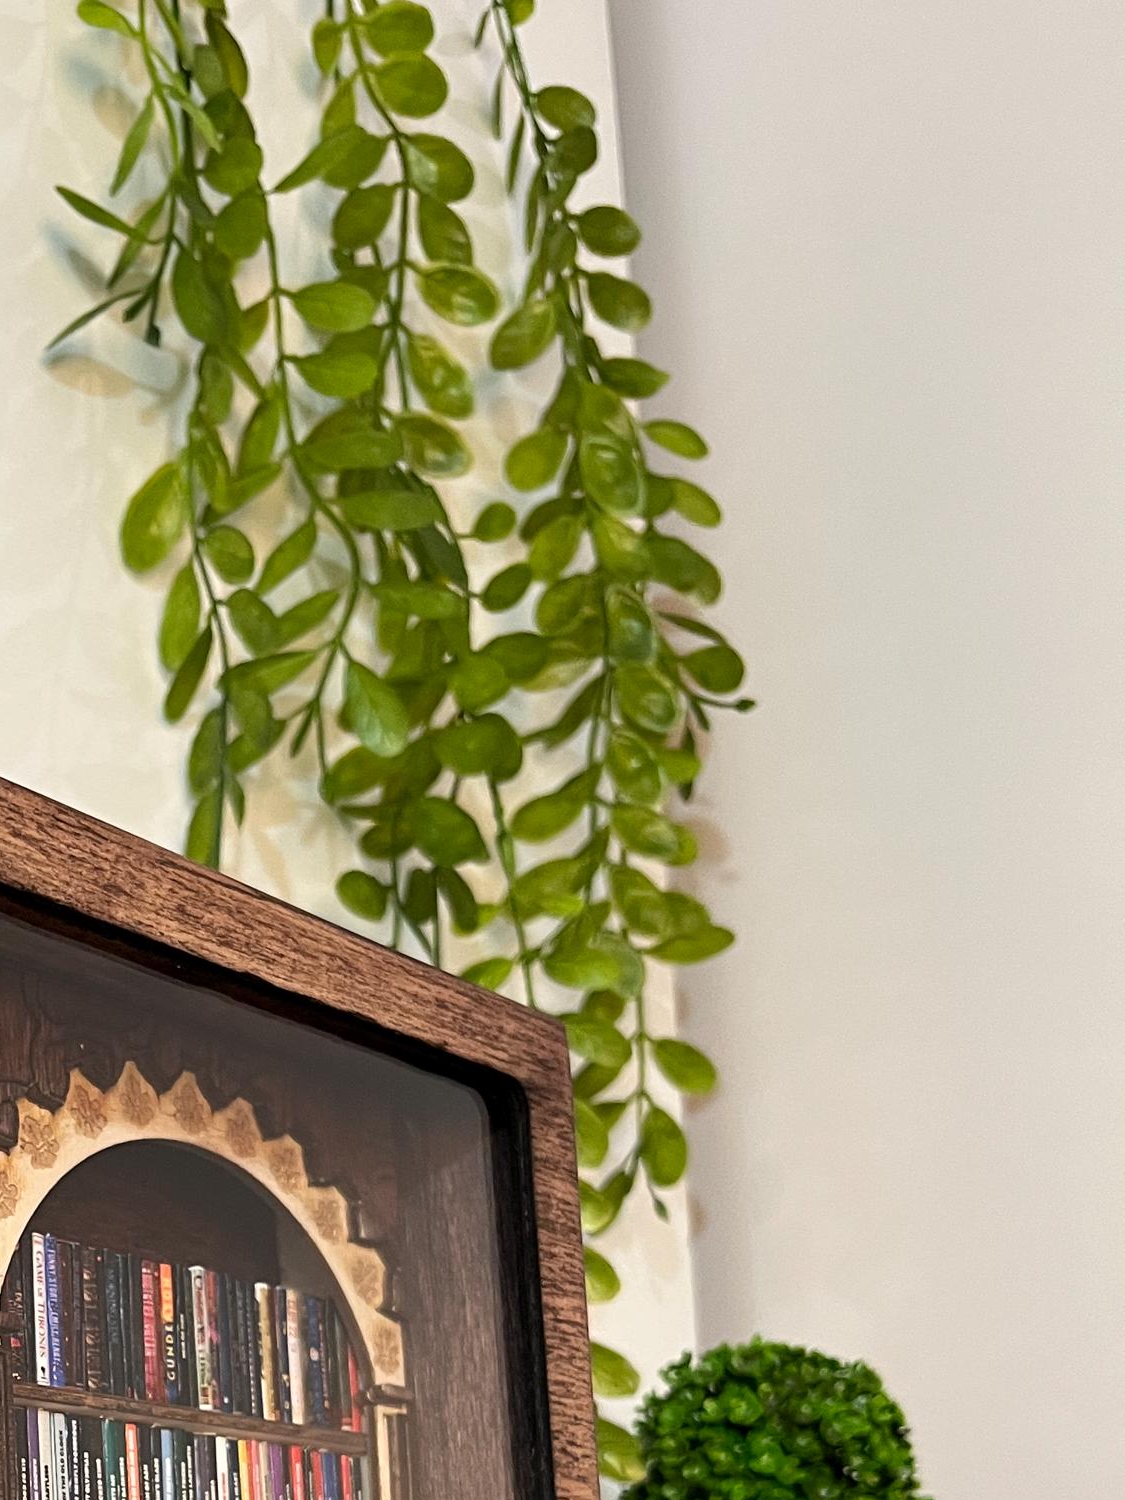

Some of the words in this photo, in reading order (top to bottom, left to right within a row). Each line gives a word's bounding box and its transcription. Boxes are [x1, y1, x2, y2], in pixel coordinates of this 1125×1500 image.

[36, 1250, 45, 1284] GAME
[37, 1288, 45, 1297] OF
[37, 1302, 47, 1358] THRONES
